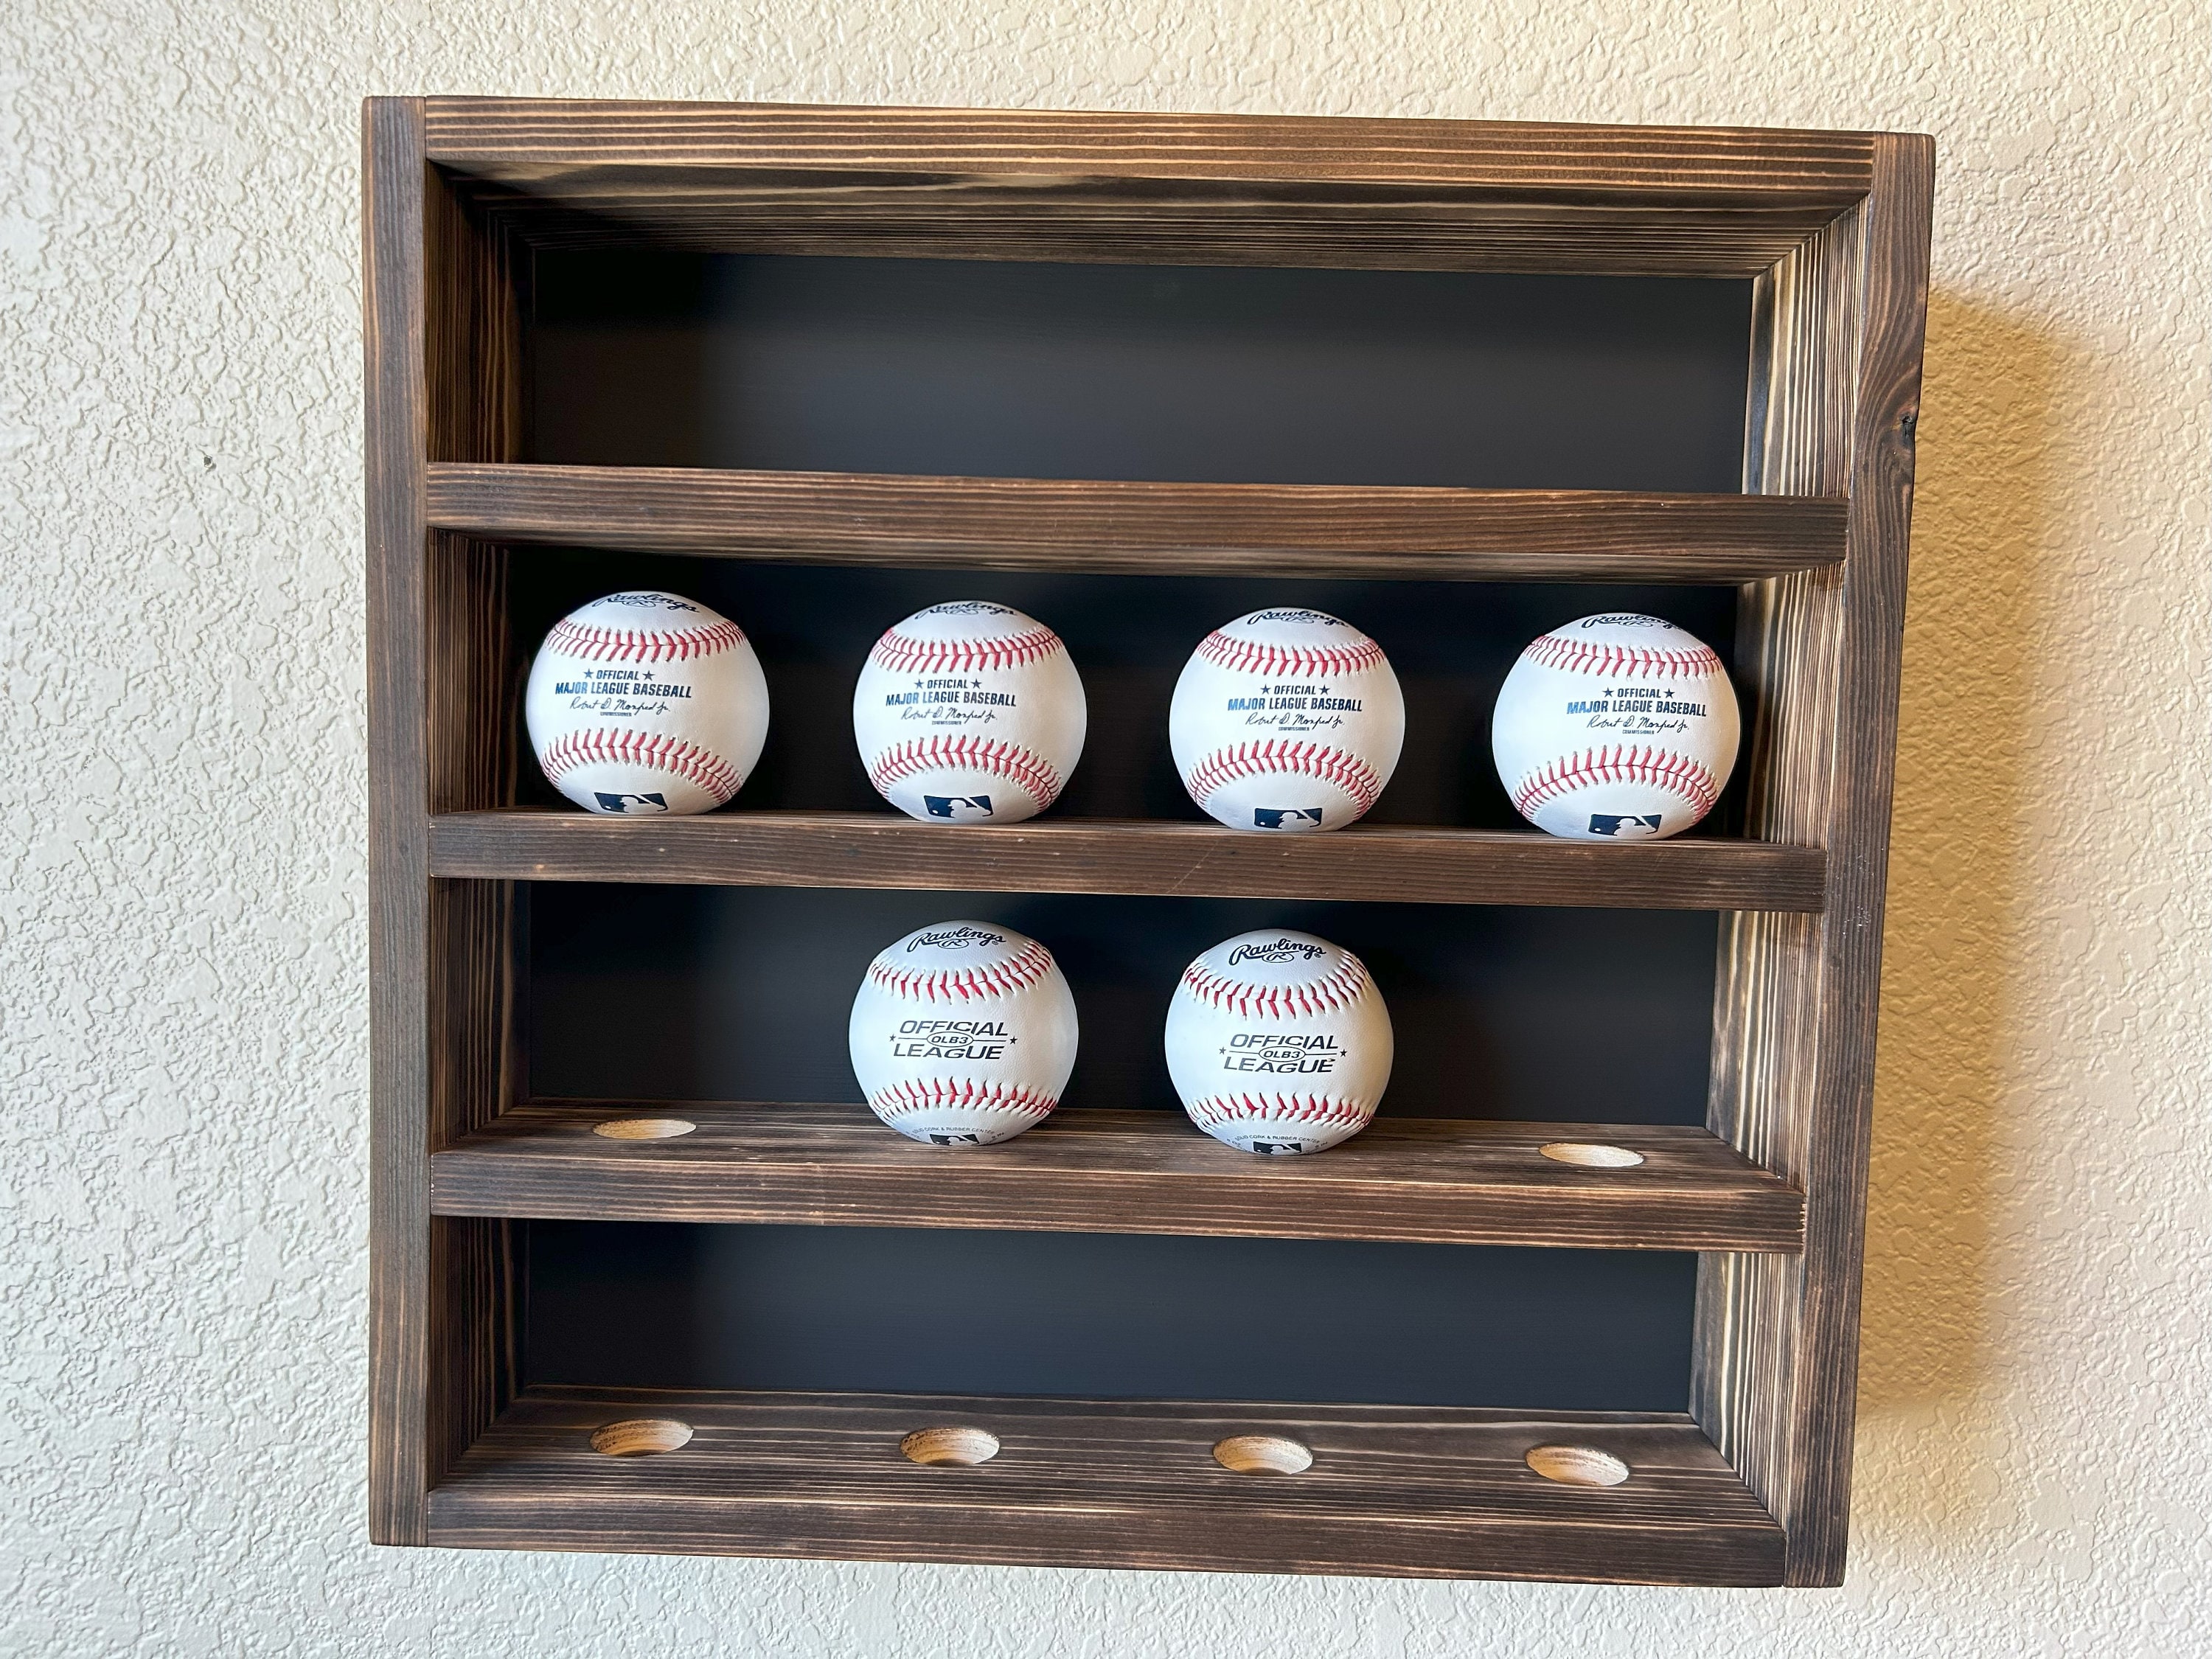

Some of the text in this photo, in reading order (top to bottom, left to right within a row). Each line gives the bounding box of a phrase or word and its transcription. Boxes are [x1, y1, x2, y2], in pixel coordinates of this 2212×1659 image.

[597, 669, 639, 680] OFFICIAL
[555, 682, 692, 698] MAJOR LEAGUE BASEBALL
[927, 679, 968, 689] OFFICIAL
[1273, 685, 1316, 695] OFFICIAL
[886, 691, 1017, 707] MAJOR LEAGUE BASEBALL
[1617, 688, 1661, 698] OFFICIAL
[1228, 698, 1363, 712] MAJOR LEAGUE BASEBALL
[1567, 700, 1707, 717] MAJOR LEAGUE BASEBALL
[907, 927, 1006, 953] Rawlings
[1229, 938, 1326, 966] Rawlings
[900, 1020, 1009, 1036] OFFICIAL
[1230, 1034, 1338, 1050] OFFICIAL
[894, 1043, 1005, 1060] LEAGUE
[1224, 1057, 1336, 1074] LEAGUE
